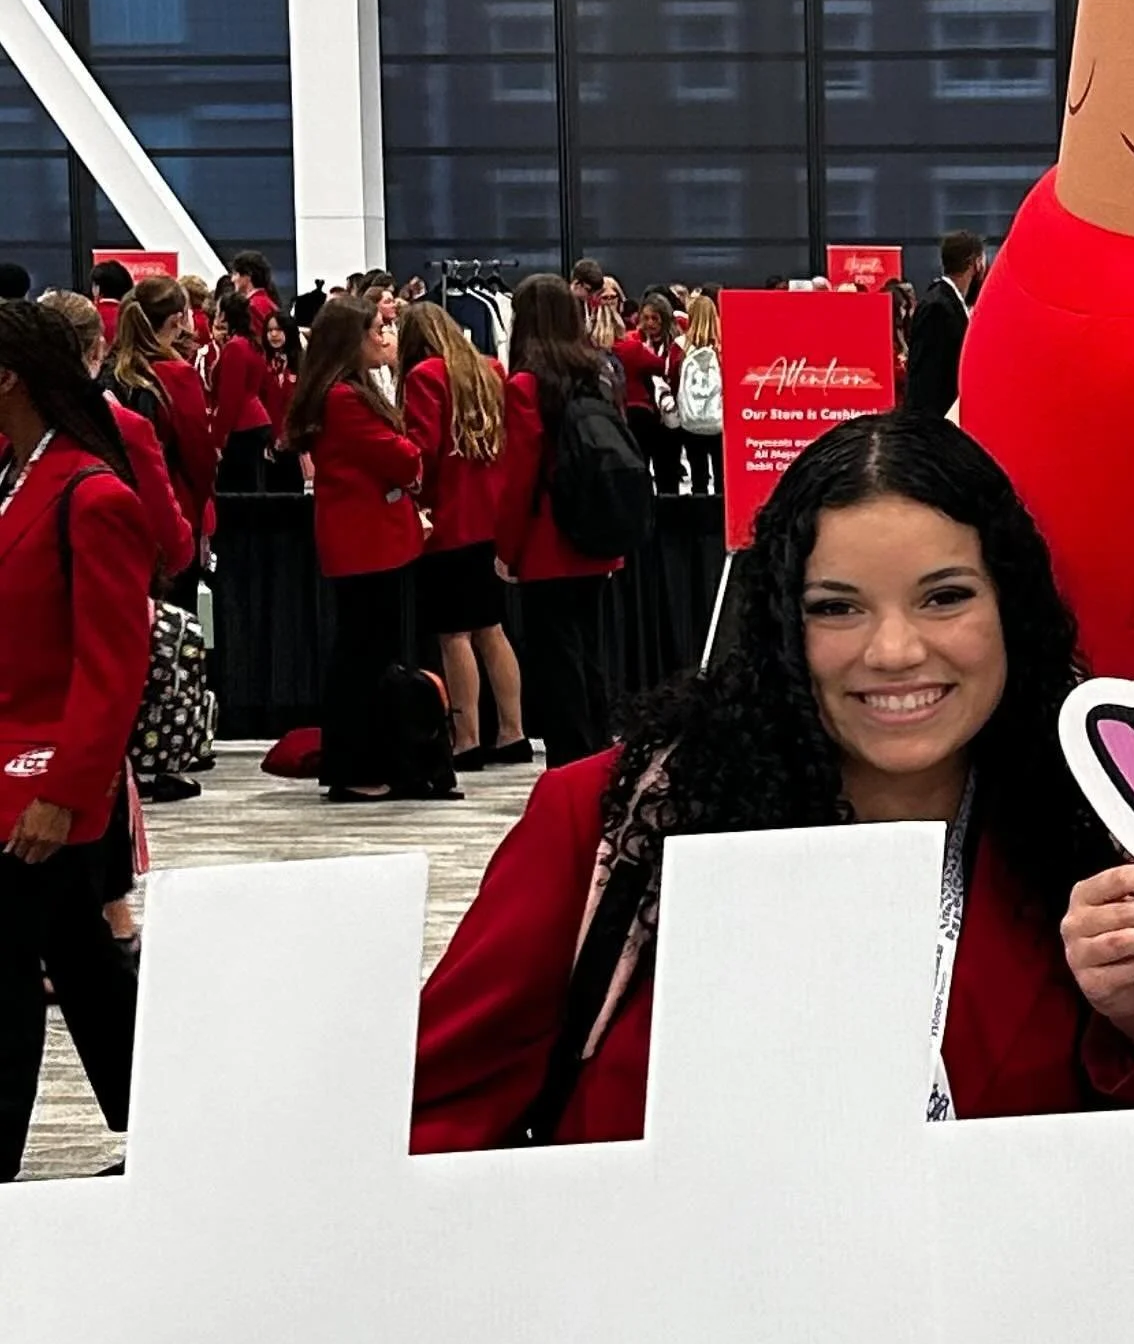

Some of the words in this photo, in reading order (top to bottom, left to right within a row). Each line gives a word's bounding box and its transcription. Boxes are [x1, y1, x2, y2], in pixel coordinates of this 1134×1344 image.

[744, 356, 870, 401] Attention
[741, 408, 768, 420] Our
[770, 408, 804, 420] Store
